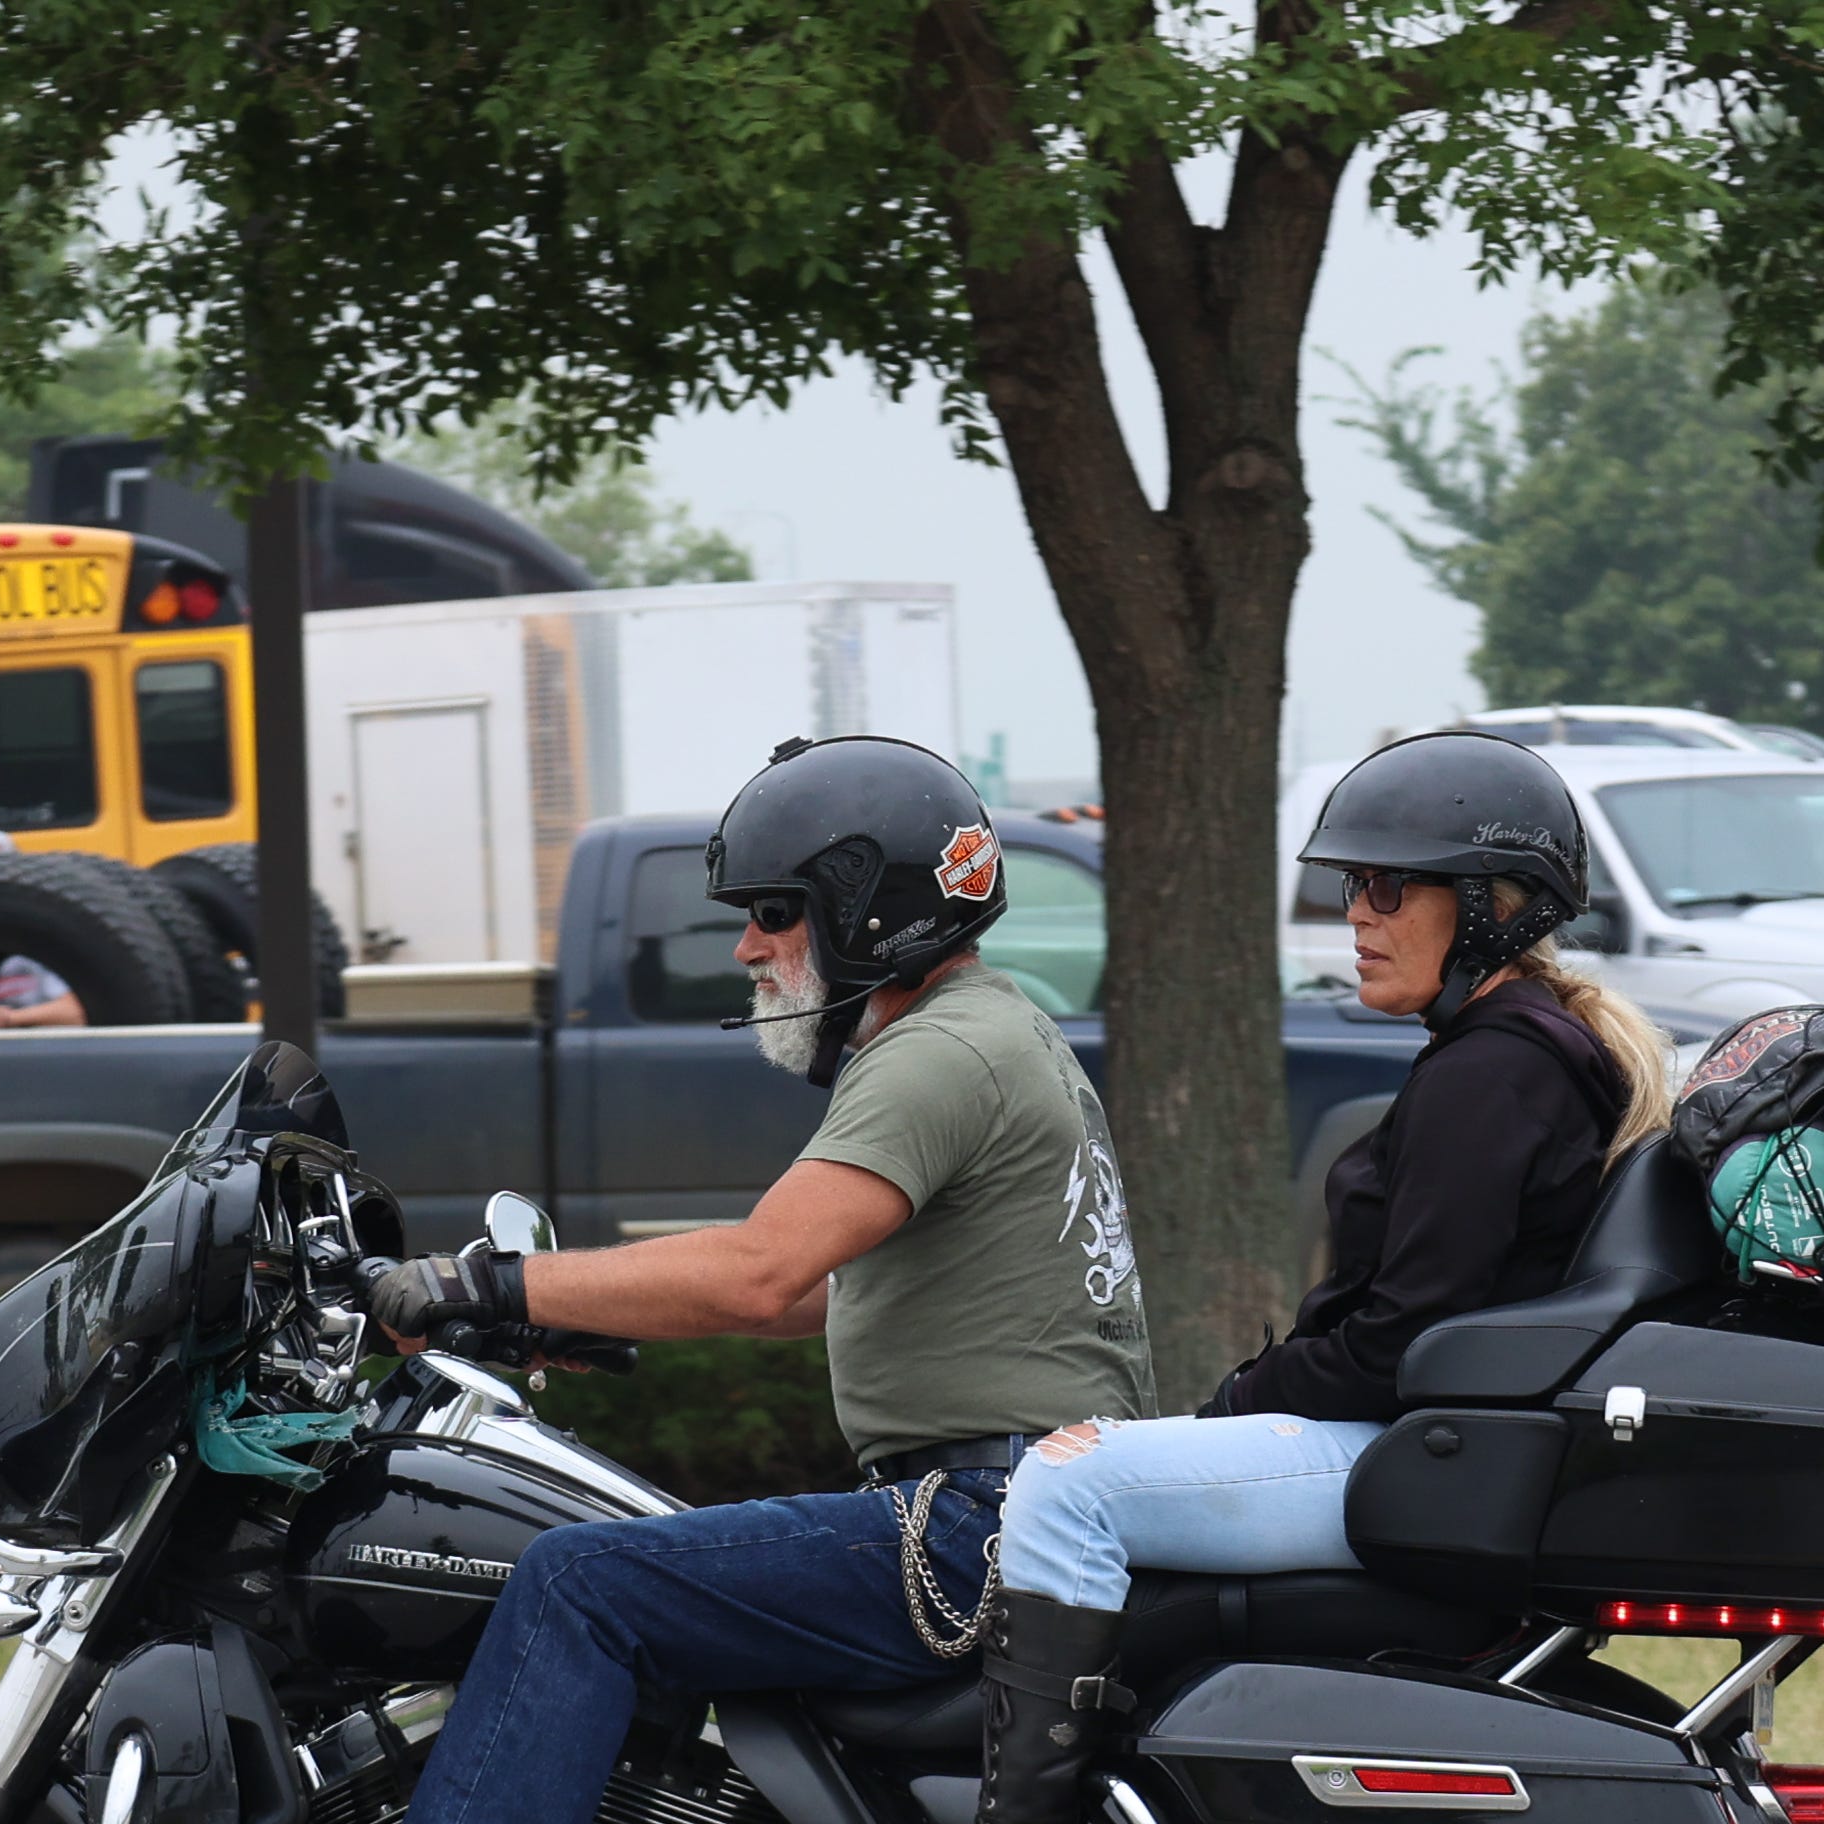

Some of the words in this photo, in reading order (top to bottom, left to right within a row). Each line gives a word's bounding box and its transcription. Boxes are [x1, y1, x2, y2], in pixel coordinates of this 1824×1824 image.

[41, 559, 107, 618] BUS
[945, 840, 996, 887] HARLEY-DAVIDSON
[952, 834, 982, 862] MOTOR
